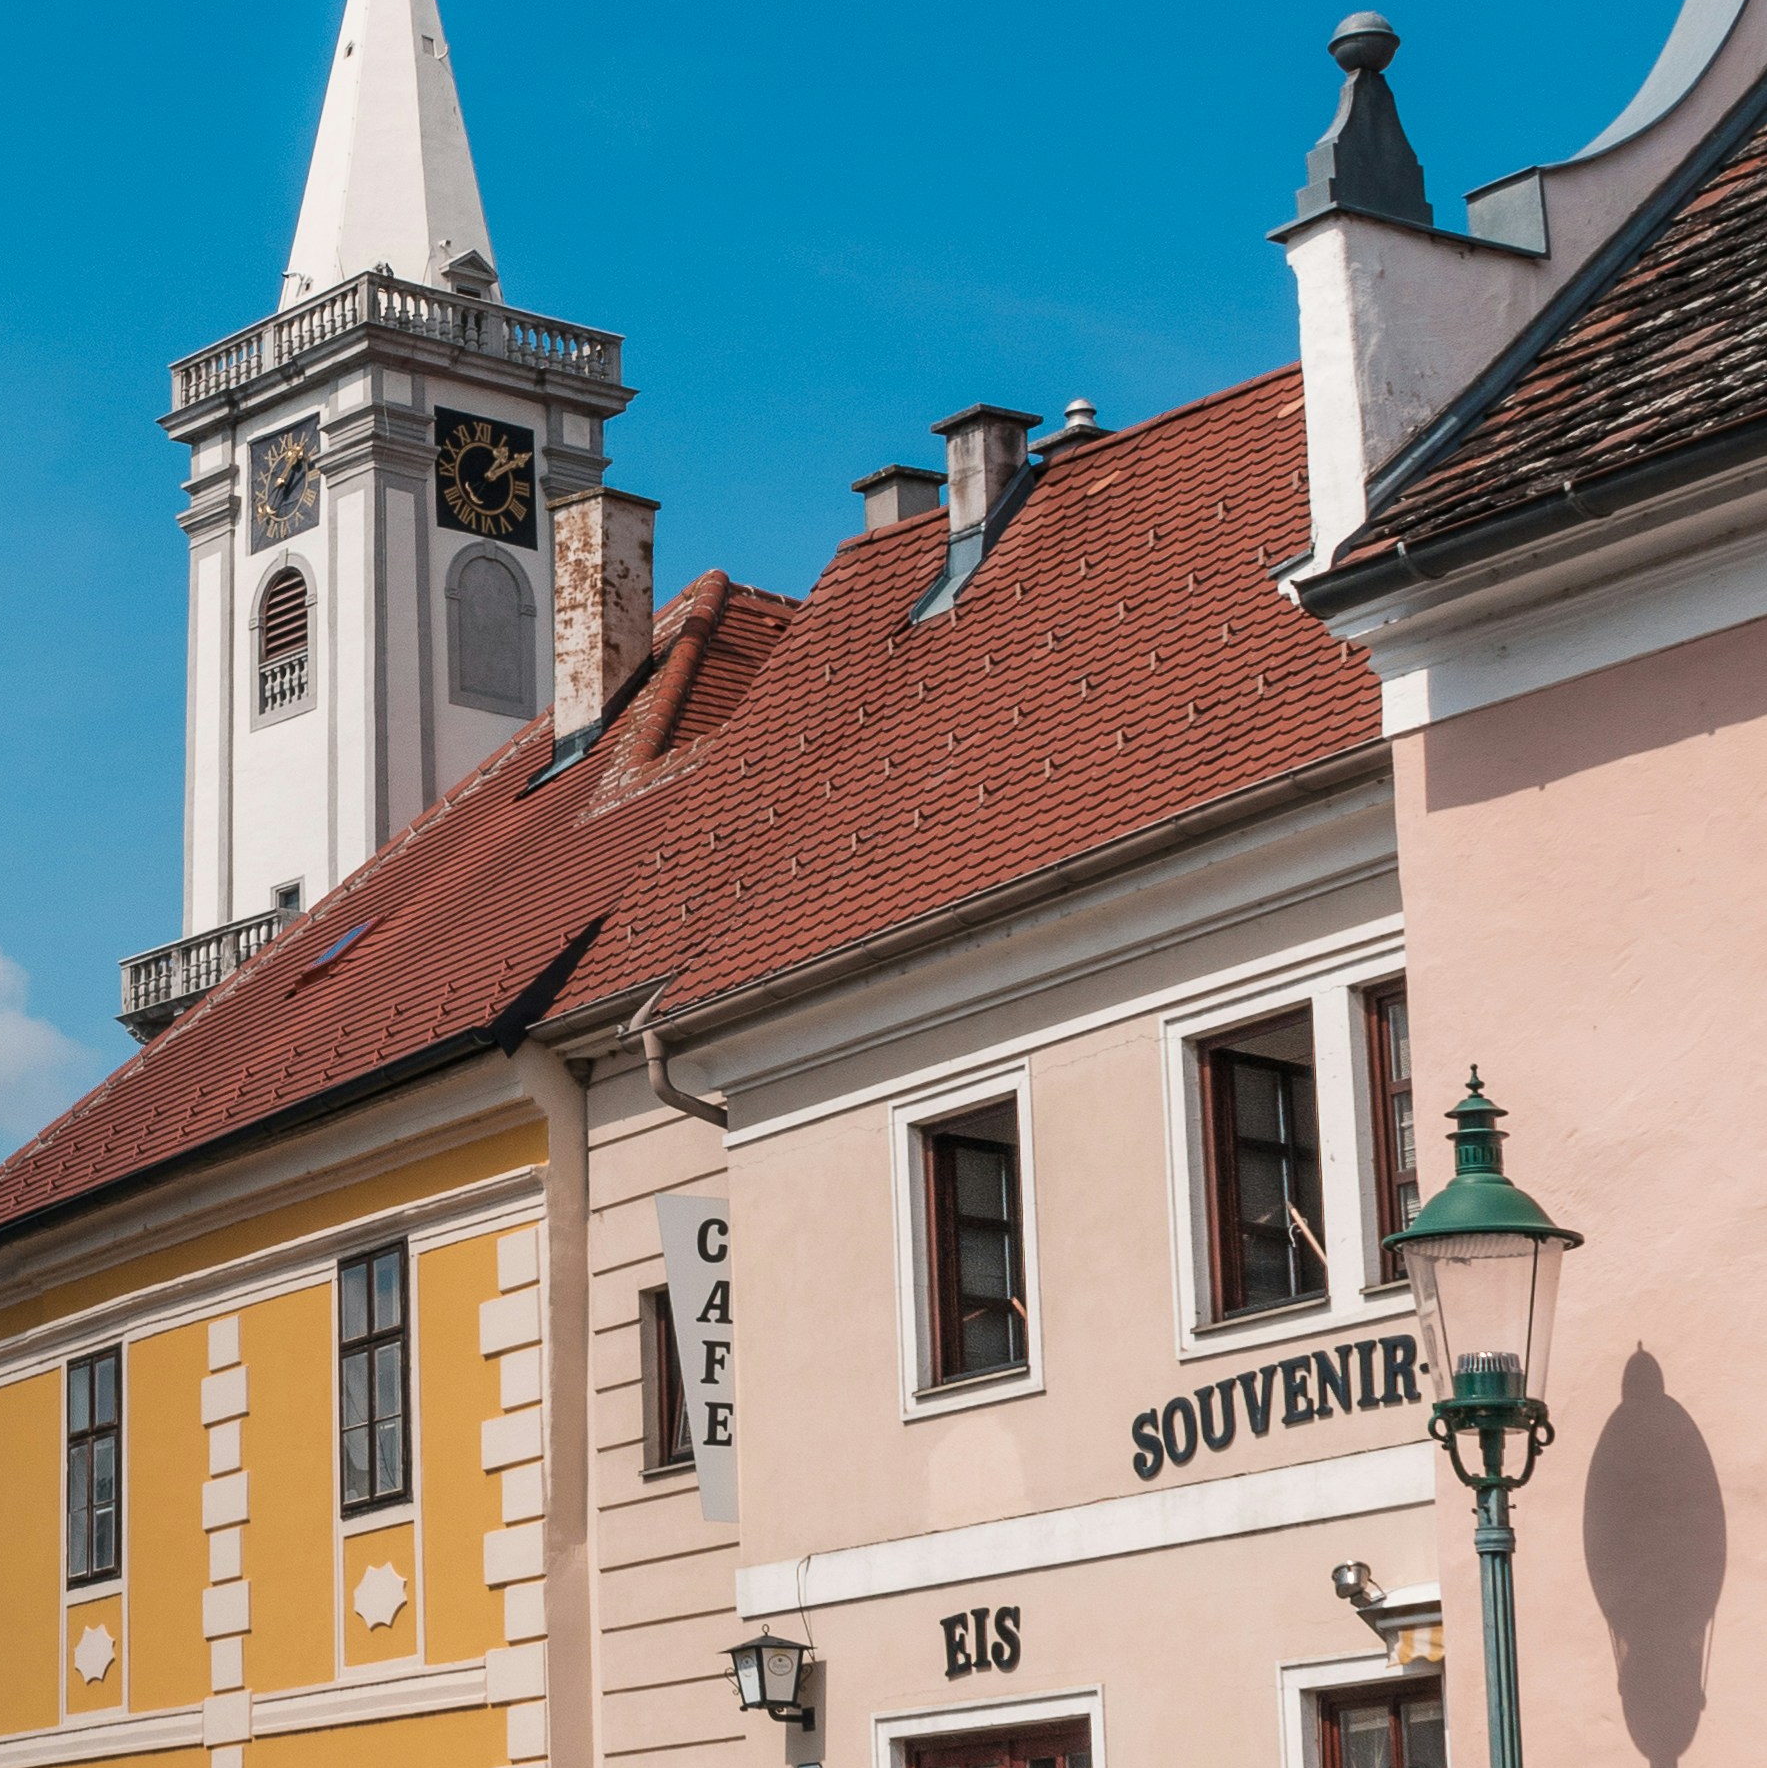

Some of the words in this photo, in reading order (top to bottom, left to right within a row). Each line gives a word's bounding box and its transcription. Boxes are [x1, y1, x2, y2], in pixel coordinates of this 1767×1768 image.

[473, 421, 492, 444] XII
[696, 1218, 733, 1446] CAFE
[940, 1606, 1021, 1677] EIS
